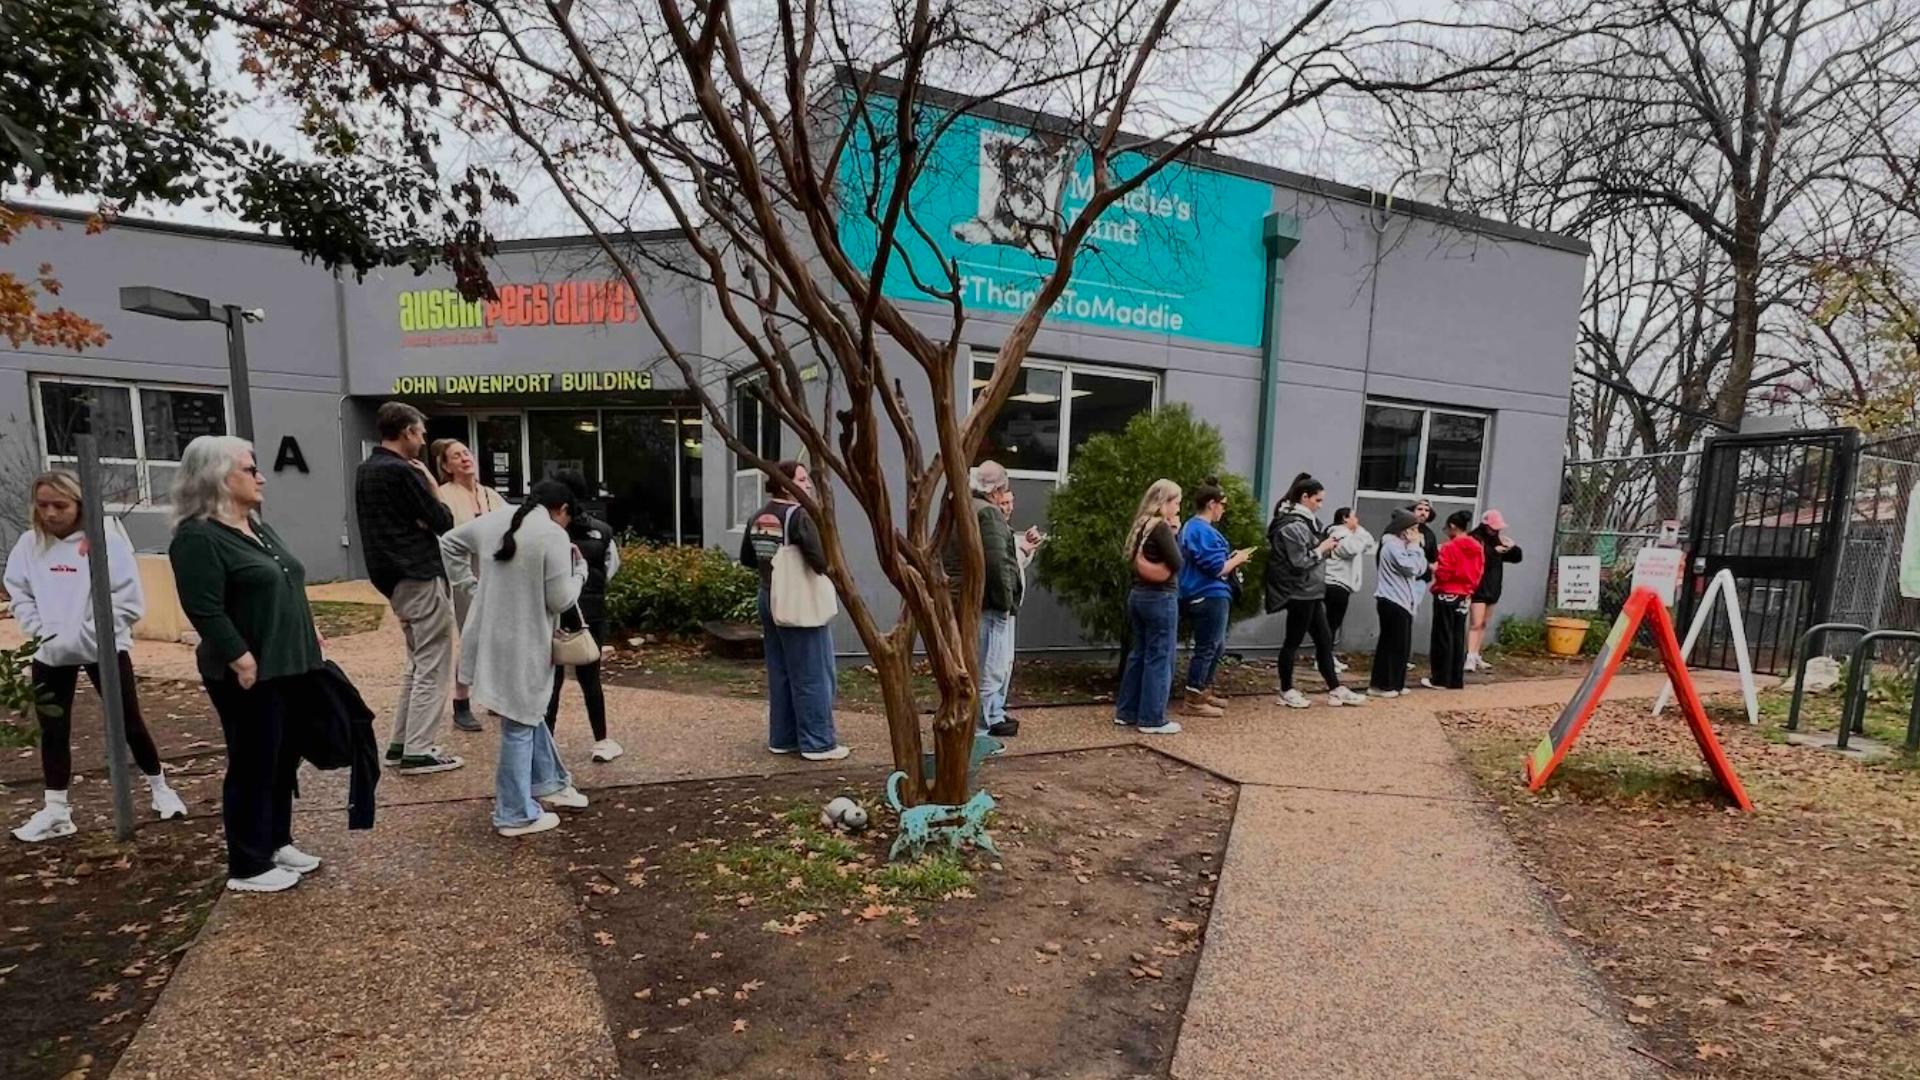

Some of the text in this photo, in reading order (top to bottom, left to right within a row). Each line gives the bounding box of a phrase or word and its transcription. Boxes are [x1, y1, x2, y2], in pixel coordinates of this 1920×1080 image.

[959, 275, 1184, 332] #ThansToMaddie
[391, 370, 652, 395] JOHN DAVENPORT BUILDING
[274, 435, 310, 475] A
